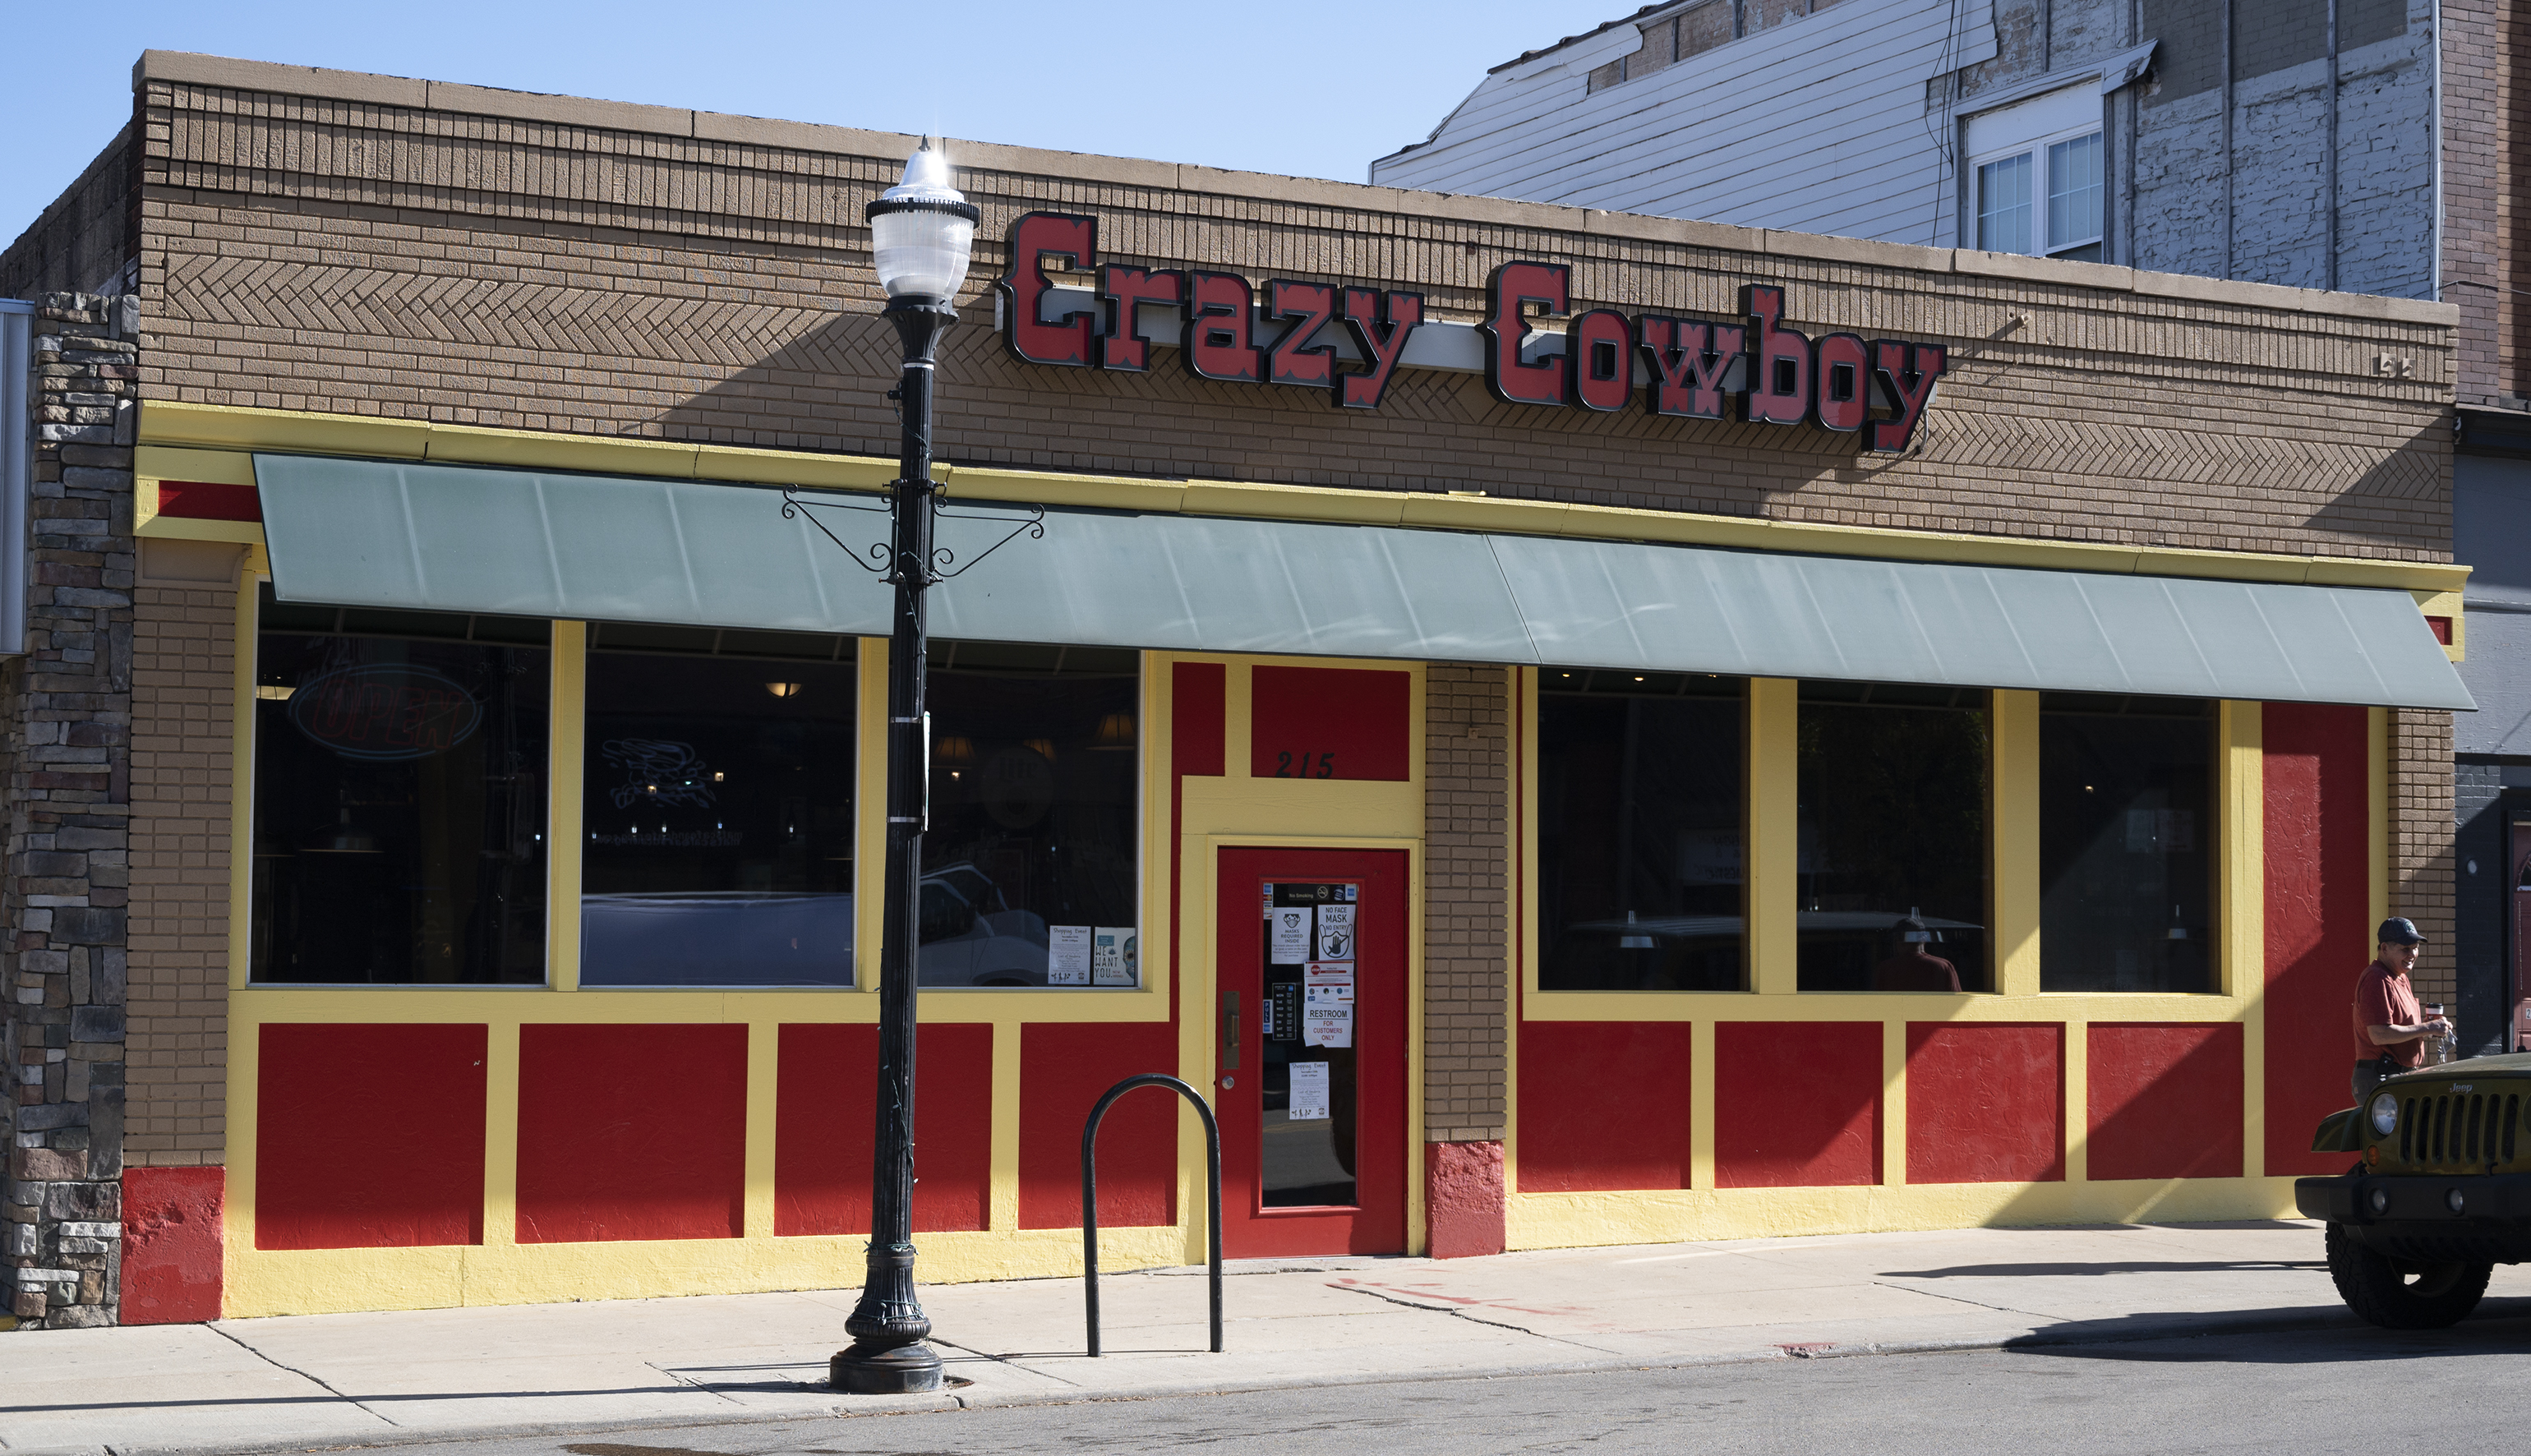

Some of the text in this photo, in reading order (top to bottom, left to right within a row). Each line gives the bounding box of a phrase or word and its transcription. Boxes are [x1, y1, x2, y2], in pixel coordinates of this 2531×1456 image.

[998, 210, 1948, 454] Crazy Cowboy
[1275, 750, 1335, 780] 215
[1325, 915, 1347, 923] MASK
[1095, 946, 1107, 956] WE
[1095, 956, 1118, 967] WANT
[1095, 968, 1113, 978] YOU.
[1309, 1010, 1348, 1018] RESTROOM
[2449, 1082, 2473, 1094] Jeep
